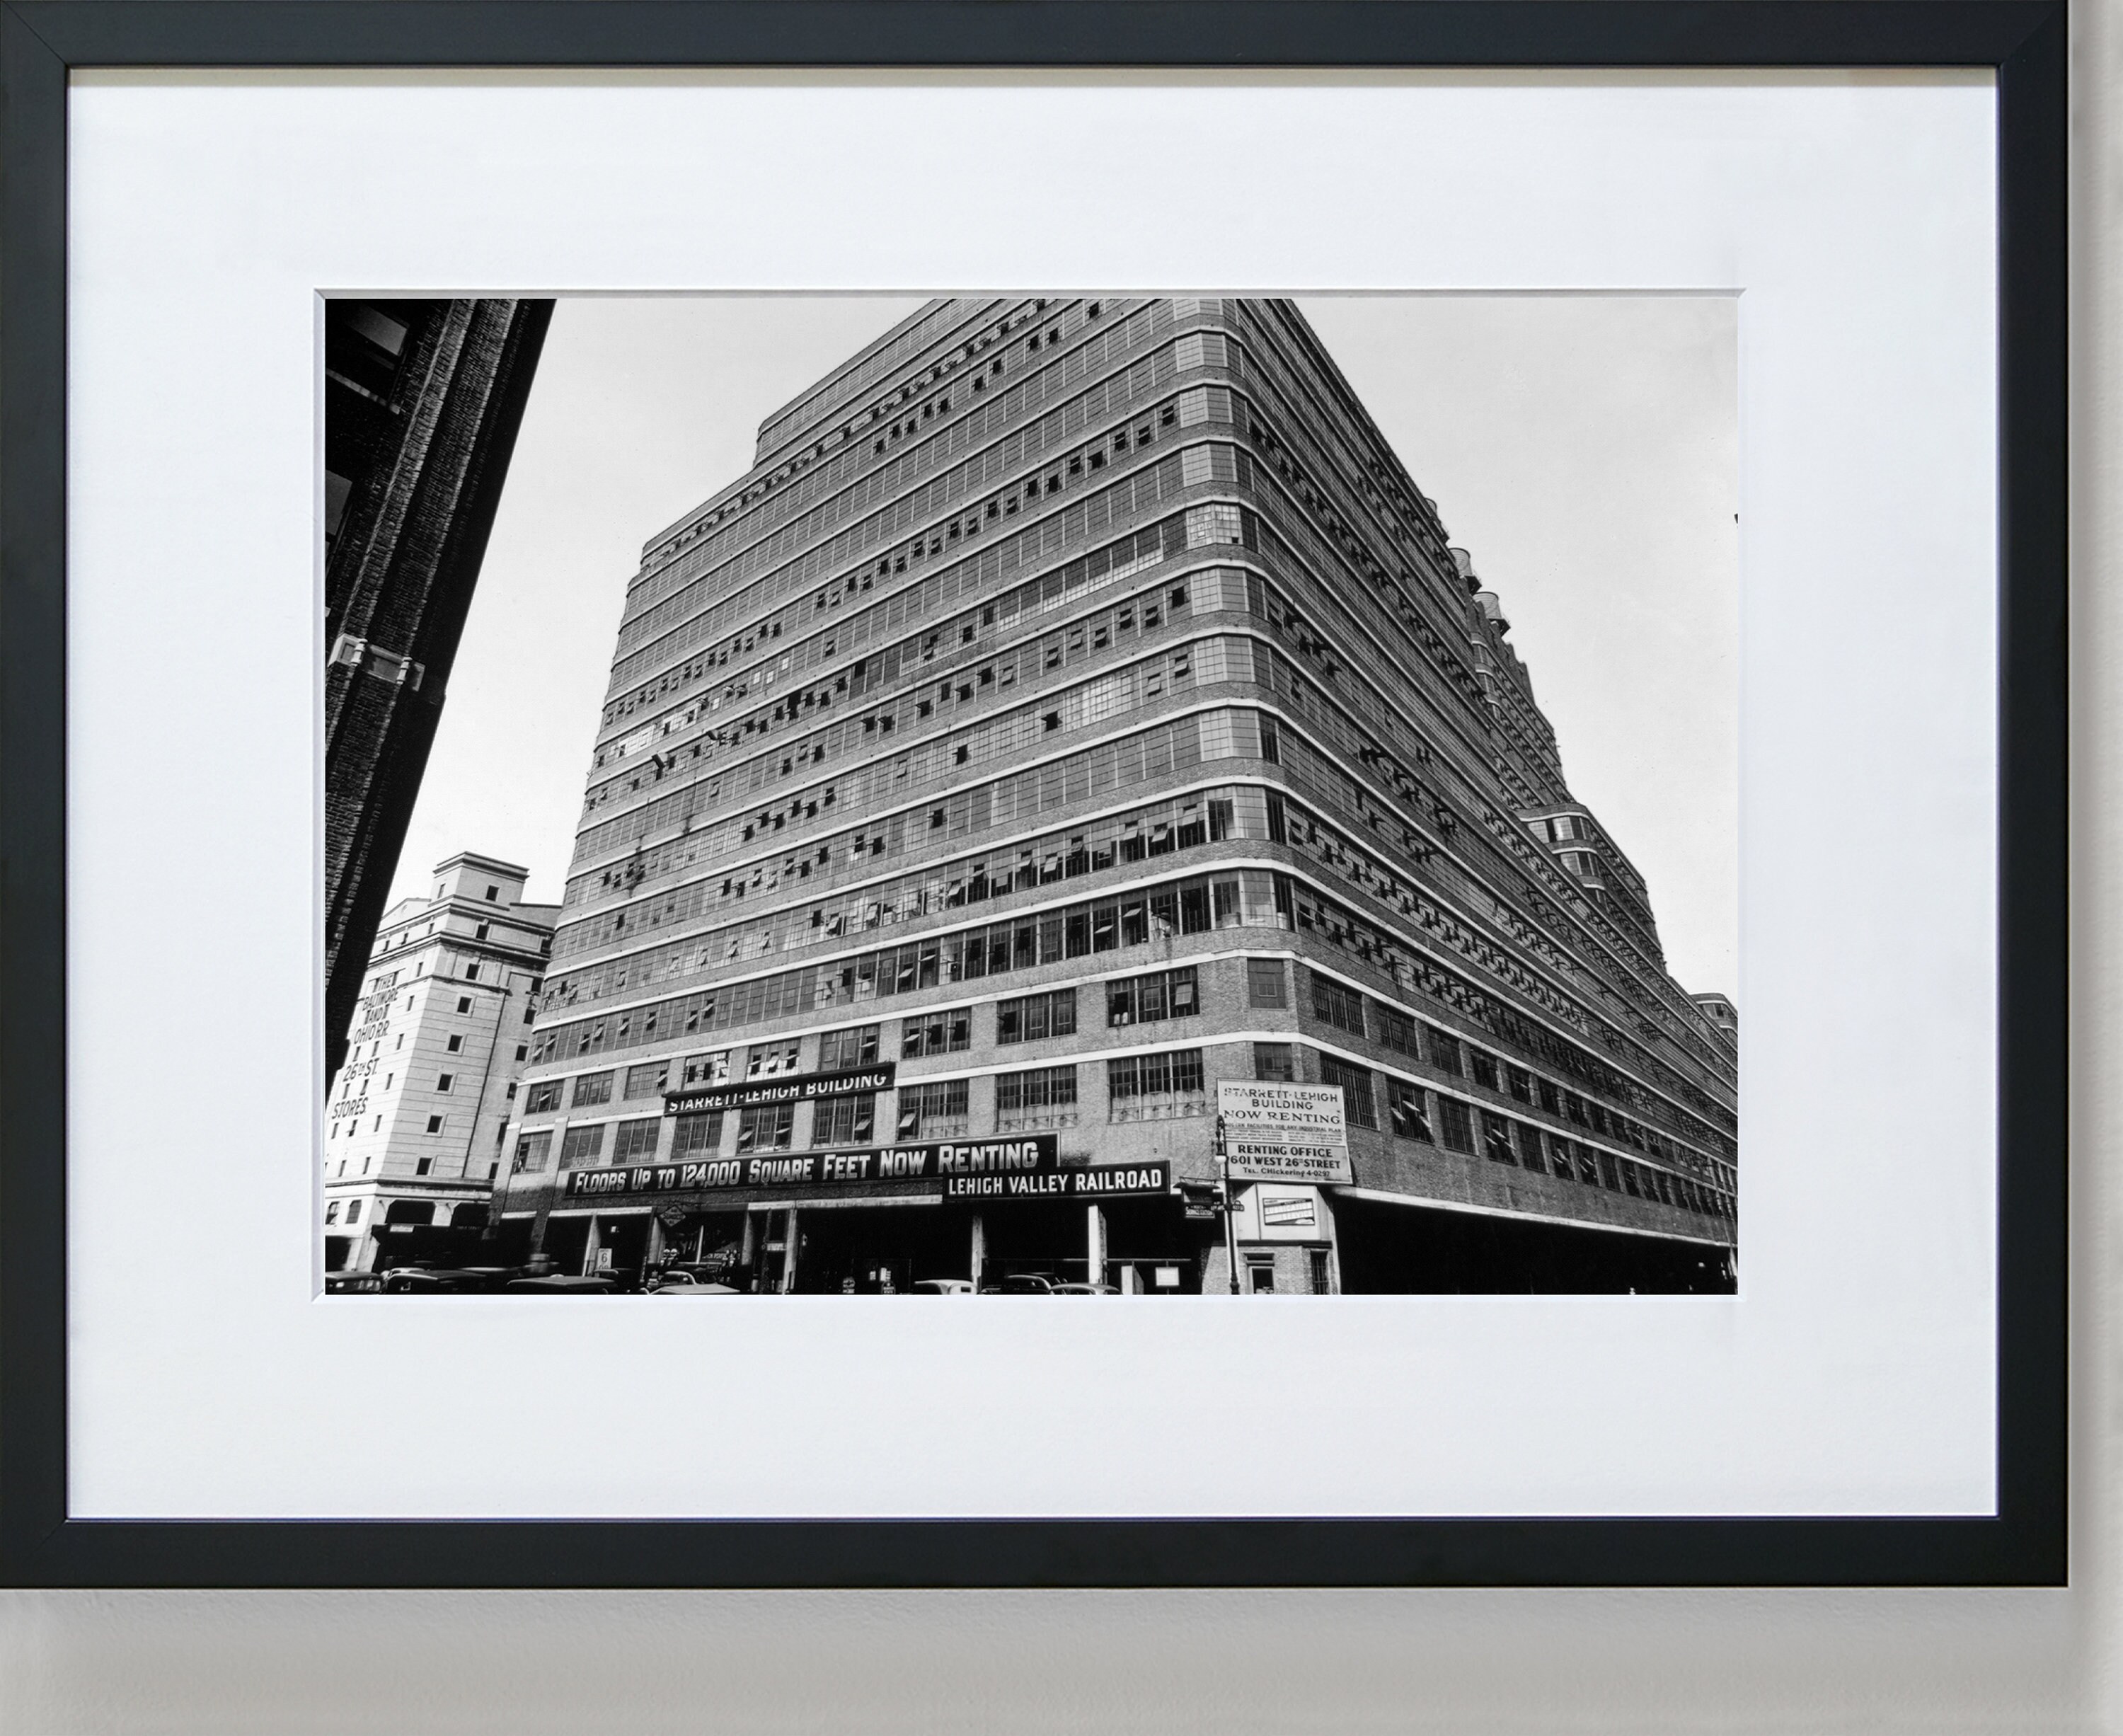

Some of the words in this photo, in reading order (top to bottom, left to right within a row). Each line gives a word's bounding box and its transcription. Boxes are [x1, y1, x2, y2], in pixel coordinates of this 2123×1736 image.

[379, 975, 393, 992] THE
[362, 987, 398, 1011] BALTIMORE
[368, 1006, 383, 1024] AND
[805, 1074, 887, 1096] BUILDING
[1252, 1098, 1313, 1110] BUILDING
[1224, 1109, 1262, 1120] NOW
[1267, 1110, 1341, 1125] RENTING
[1238, 1144, 1287, 1156] RENTING
[1290, 1146, 1333, 1158] OFFICE
[574, 1171, 627, 1194] FLOORS
[631, 1168, 652, 1190] UP
[657, 1168, 676, 1189] TO
[679, 1160, 742, 1189] 124,000
[747, 1158, 815, 1186] SQUARE
[822, 1154, 871, 1180] FEET
[879, 1149, 928, 1178] NOW
[937, 1141, 1040, 1174] RENTING
[1230, 1155, 1250, 1165] 601
[1254, 1156, 1282, 1166] WEST
[1304, 1158, 1341, 1169] STREET
[948, 1176, 1003, 1195] LEHIGH
[1008, 1173, 1069, 1194] VALLEY
[1075, 1168, 1162, 1192] RAILROAD
